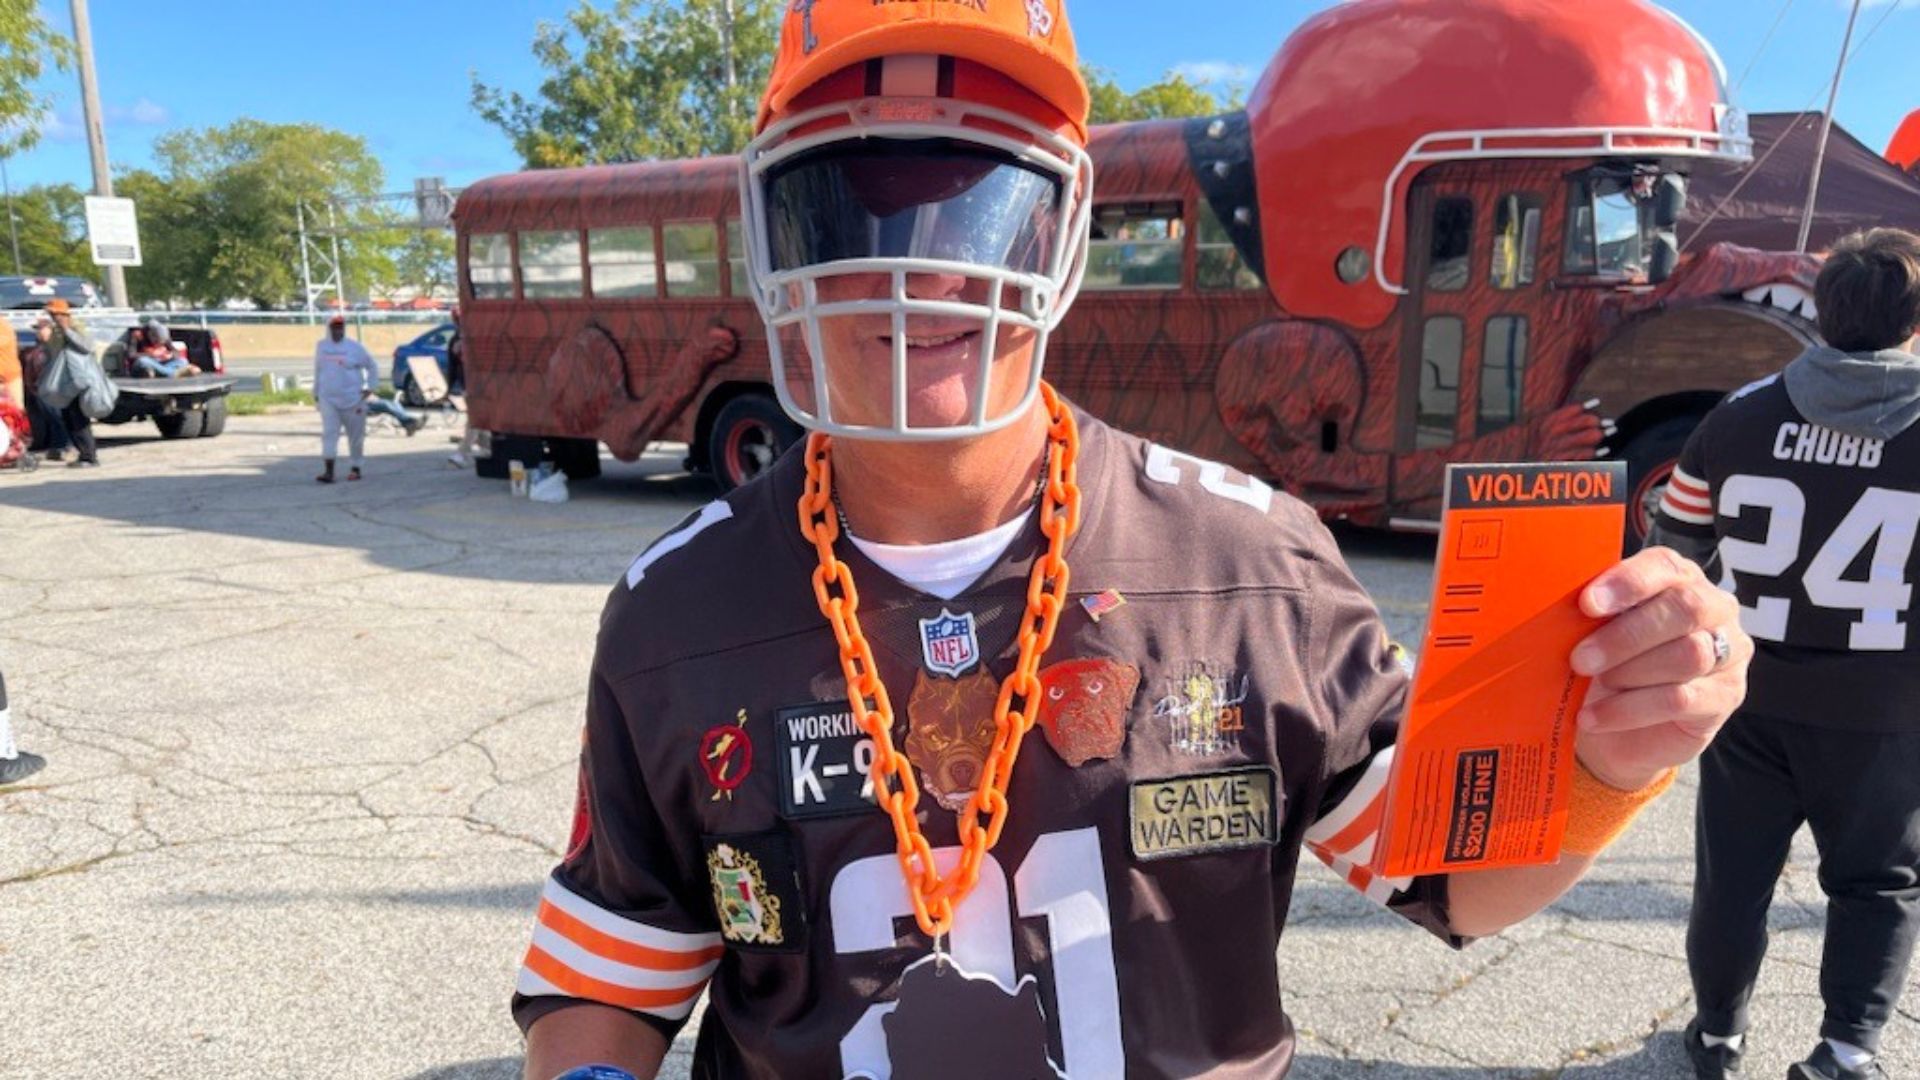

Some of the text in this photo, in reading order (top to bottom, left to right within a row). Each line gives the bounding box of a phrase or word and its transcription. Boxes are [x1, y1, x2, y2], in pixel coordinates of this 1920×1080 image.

[1773, 421, 1885, 469] CHUBB
[1467, 471, 1612, 503] VIOLATION
[1716, 473, 1919, 652] 24
[930, 637, 970, 664] NFL
[788, 712, 866, 742] WORKIN
[1219, 706, 1244, 732] 21
[790, 739, 876, 805] K-9
[1548, 750, 1558, 770] FOR
[1153, 778, 1252, 813] GAME
[1460, 755, 1474, 807] VIOLATION
[1462, 755, 1494, 858] $200 FINE
[1140, 810, 1267, 848] WARDEN
